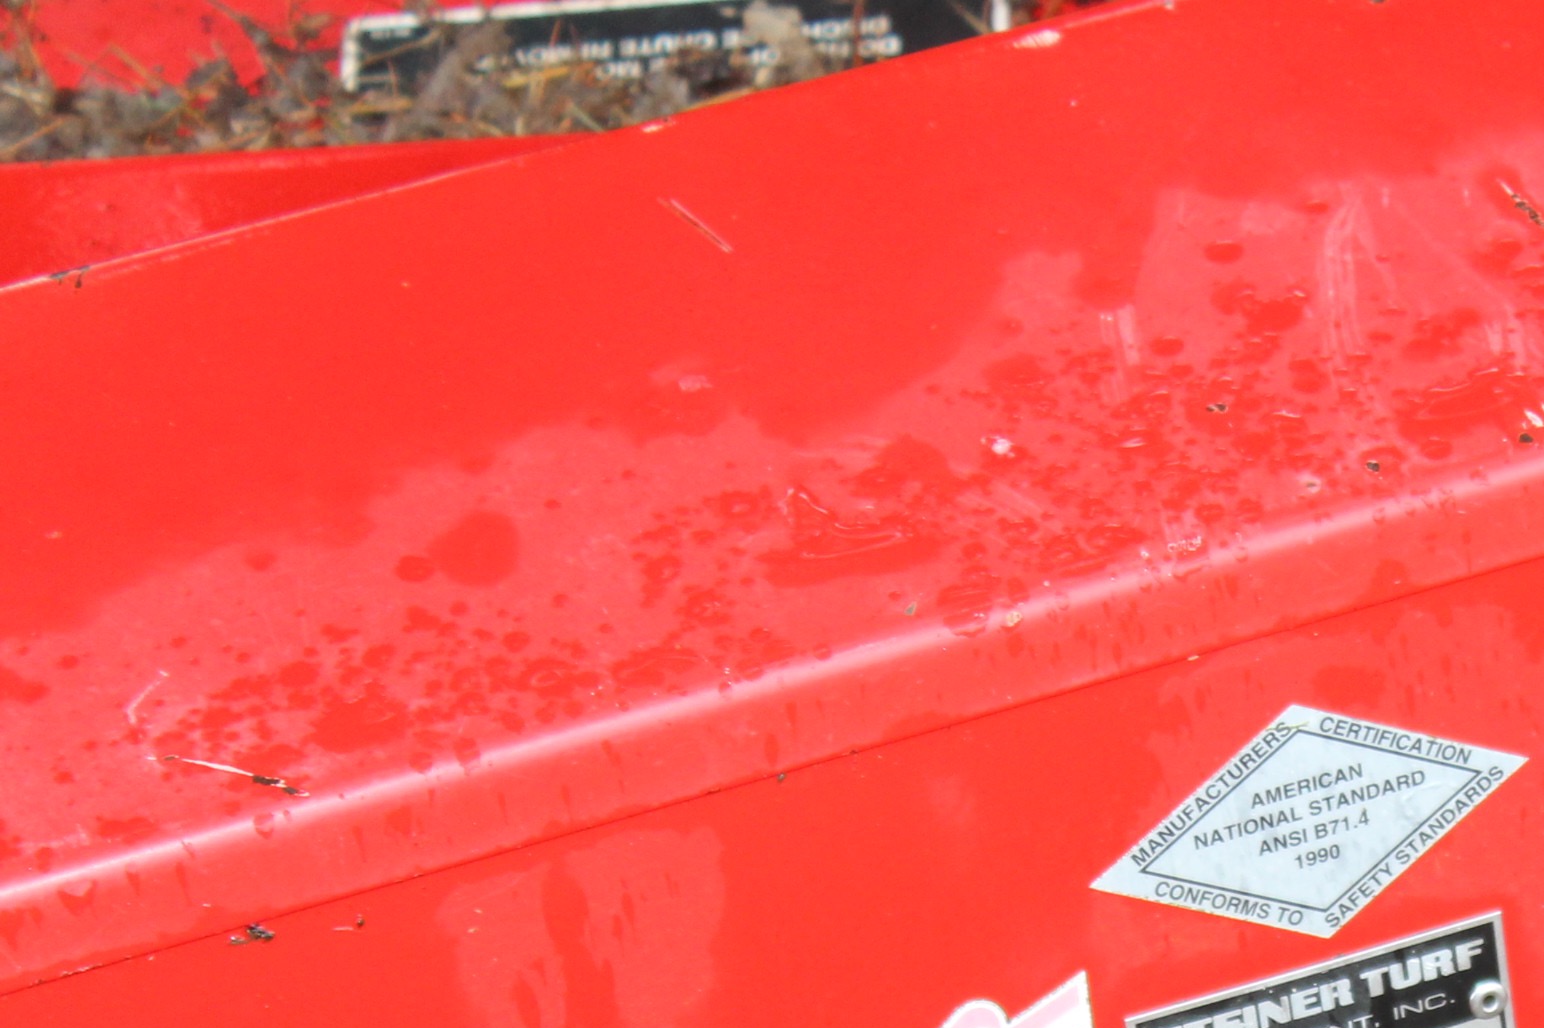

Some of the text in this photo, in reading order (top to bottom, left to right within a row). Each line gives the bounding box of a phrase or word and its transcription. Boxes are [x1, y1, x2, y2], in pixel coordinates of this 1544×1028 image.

[618, 32, 717, 58] CHUTE
[1318, 716, 1472, 765] CERTIFICATION
[1130, 721, 1292, 867] MANUFACTURERS
[1250, 763, 1364, 809] AMERICAN
[1193, 770, 1426, 850] NATIONAL STANDARD
[1258, 810, 1370, 857] ANSI B71.4
[1295, 844, 1341, 870] 1990
[1325, 766, 1505, 929] SAFETY STANDARDS
[1154, 881, 1304, 927] CONFORMS TO
[1360, 938, 1485, 998] TURF
[1393, 992, 1455, 1021] INC.
